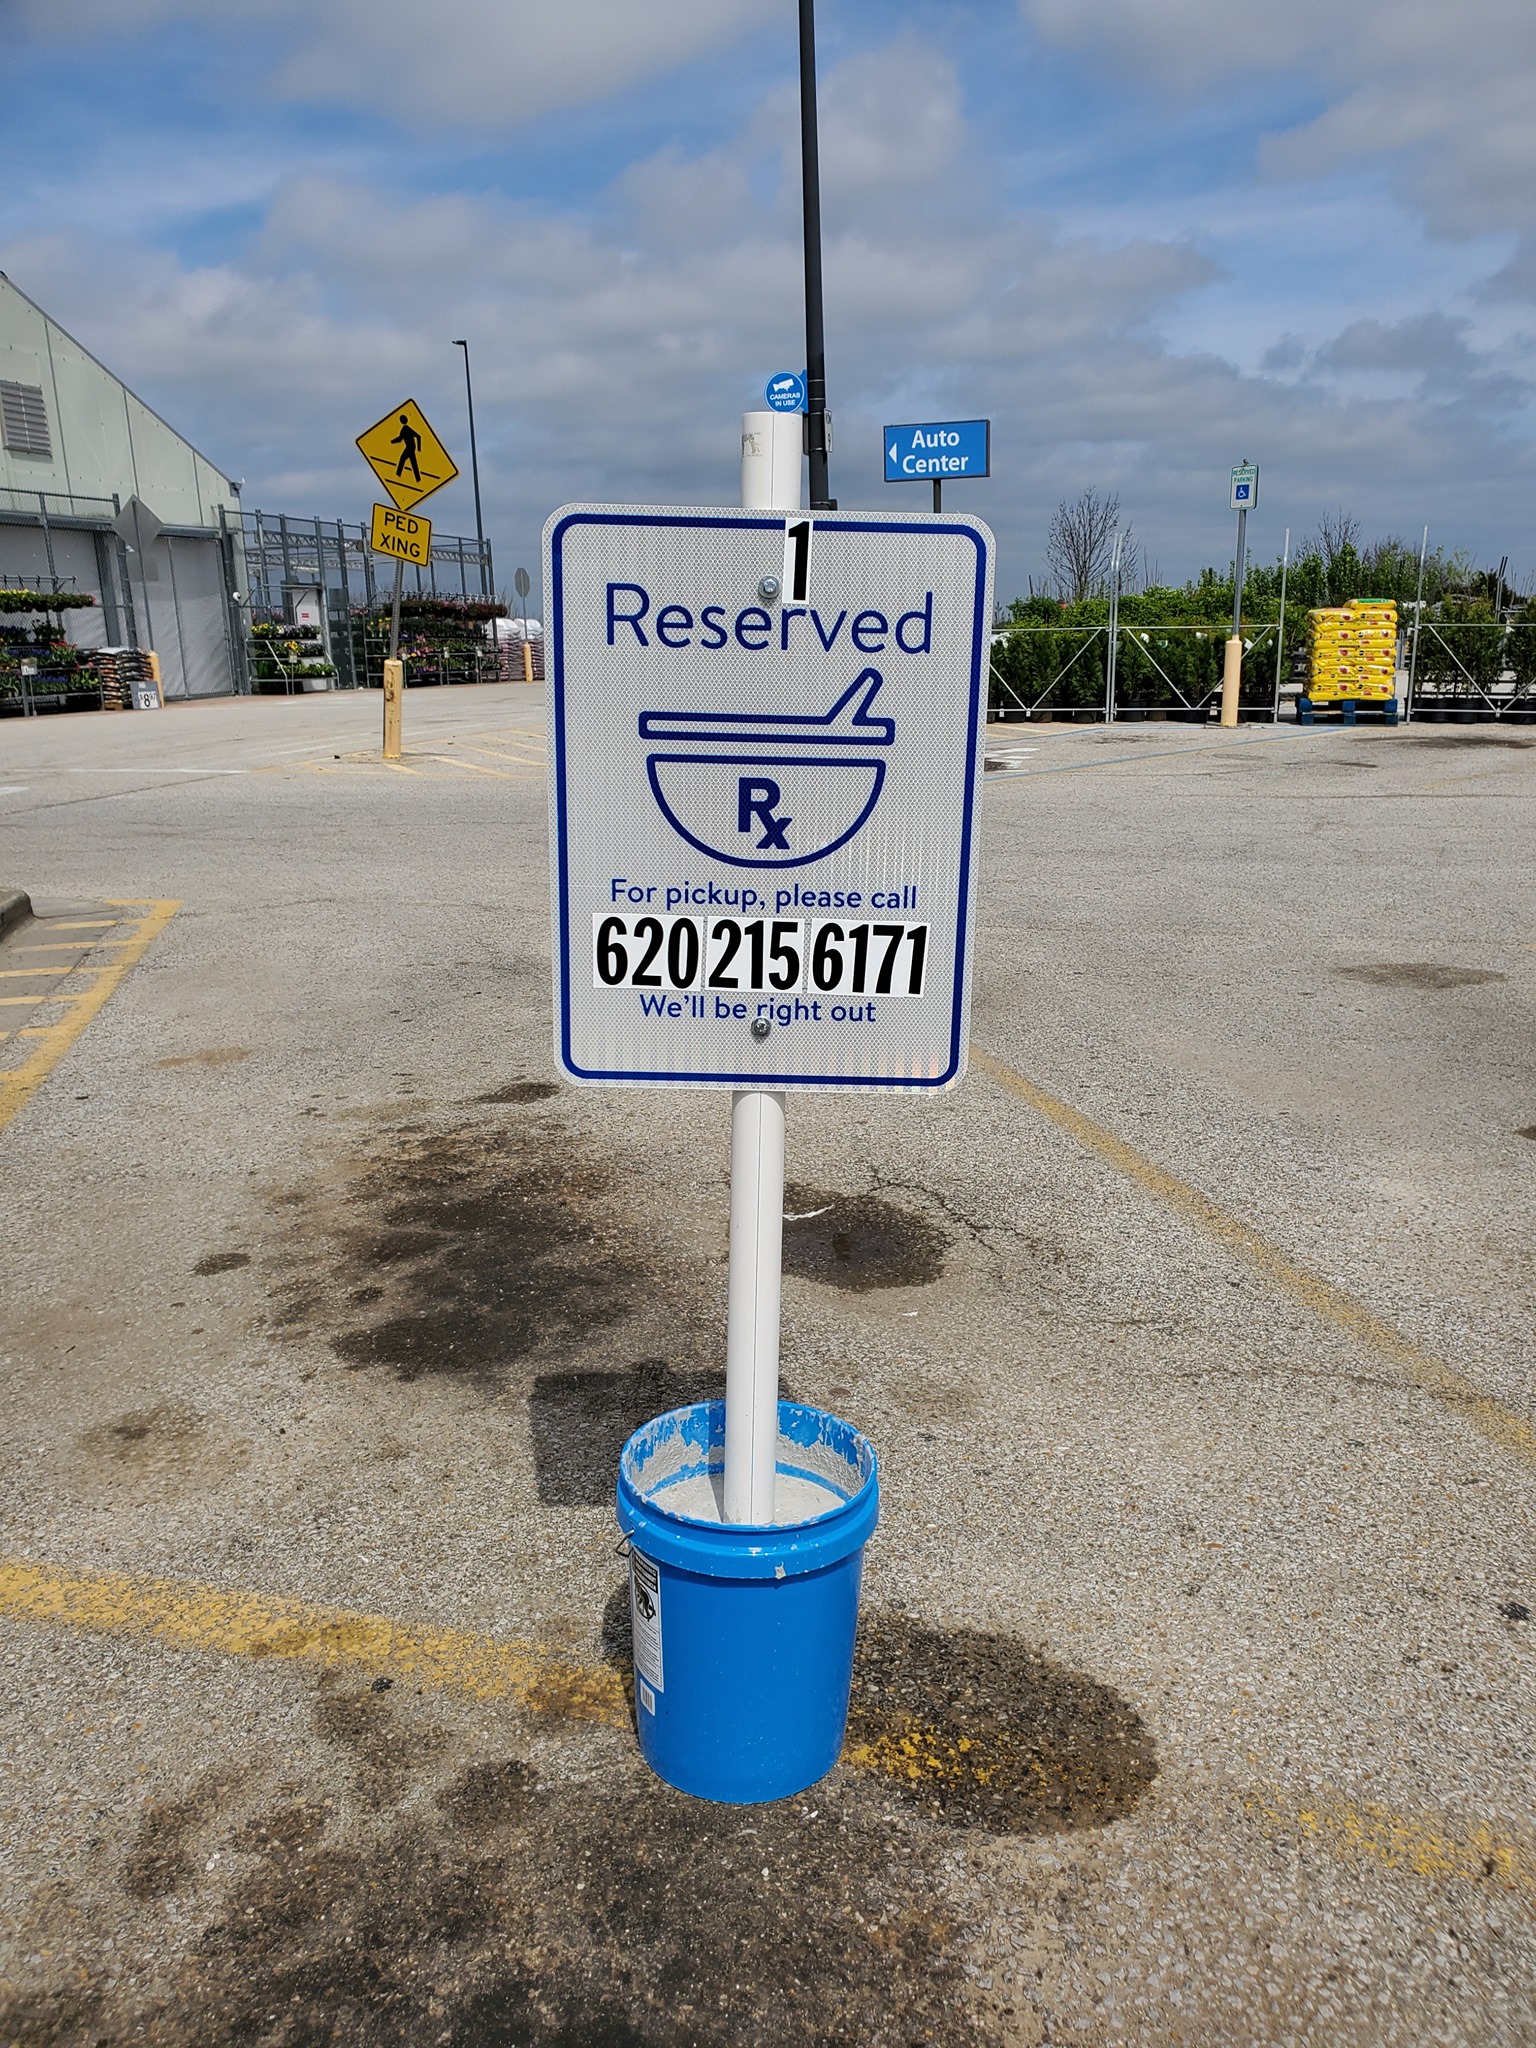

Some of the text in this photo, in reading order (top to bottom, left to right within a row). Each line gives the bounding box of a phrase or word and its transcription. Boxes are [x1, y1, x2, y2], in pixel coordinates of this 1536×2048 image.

[770, 392, 801, 401] CAMERAS
[911, 430, 960, 449] Auto
[902, 455, 969, 474] Center
[385, 511, 418, 534] PED
[380, 532, 420, 557] XING
[788, 521, 810, 601] 1
[606, 582, 933, 654] Reserved
[738, 776, 793, 849] Rx
[610, 879, 917, 913] For pickup, please call
[597, 916, 928, 995] 620 215 6171
[639, 994, 877, 1026] We'll be right out
